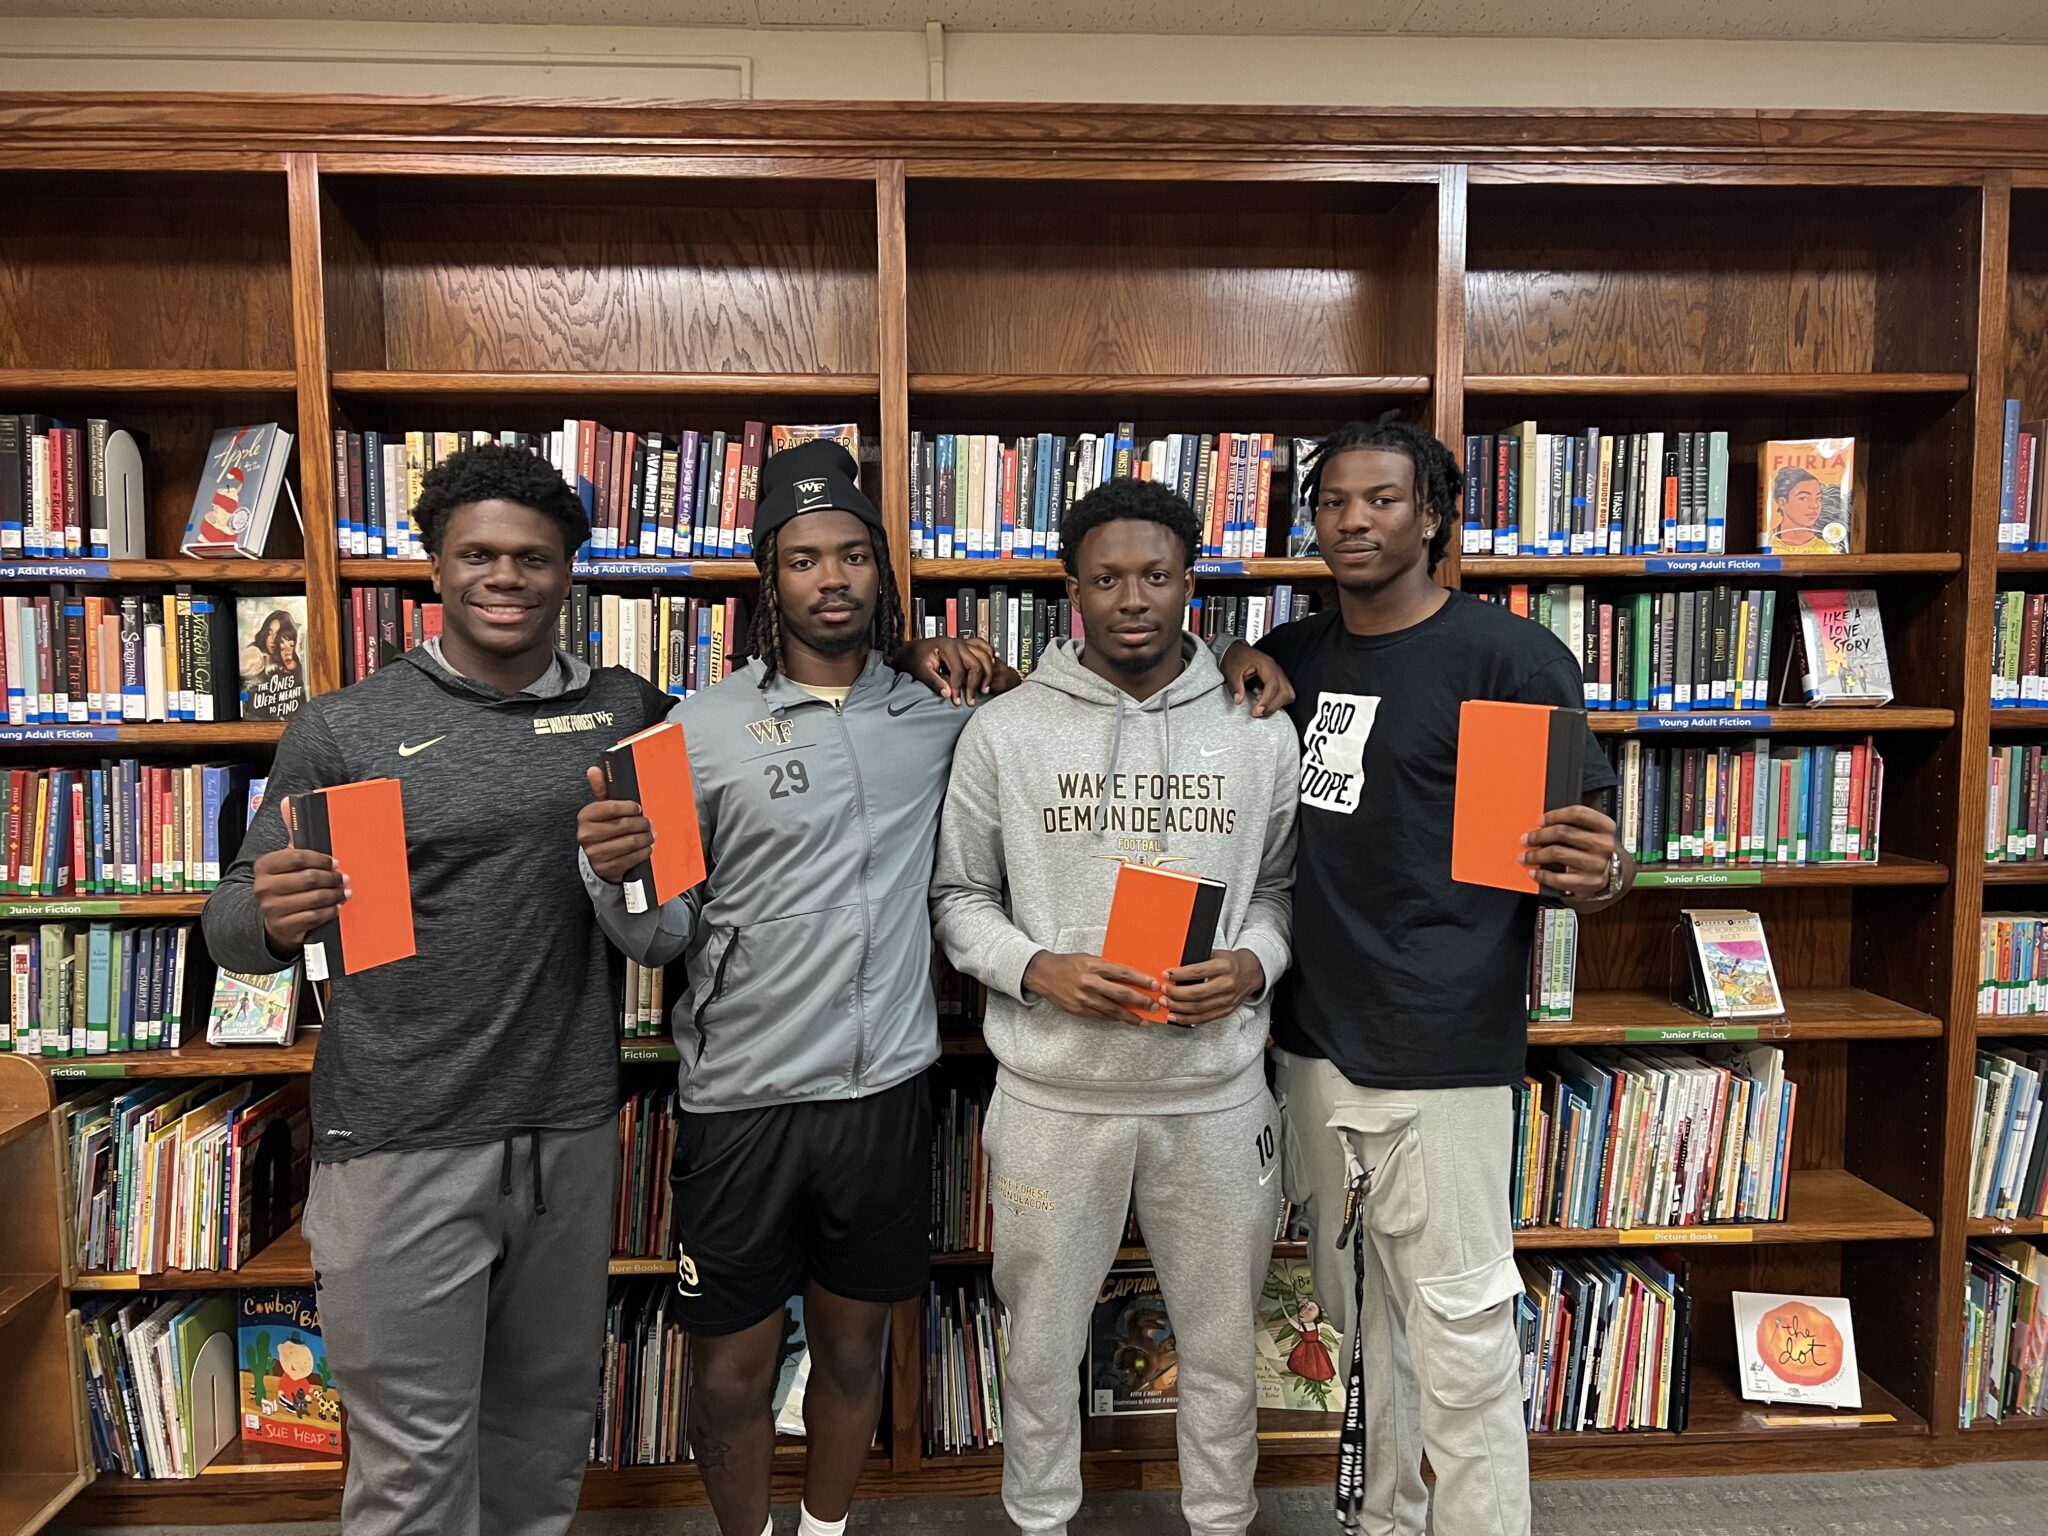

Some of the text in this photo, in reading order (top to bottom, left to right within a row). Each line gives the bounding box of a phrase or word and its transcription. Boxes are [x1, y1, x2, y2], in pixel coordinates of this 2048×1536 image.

[65, 434, 73, 455] ANNIE
[213, 428, 265, 482] Apple
[66, 457, 73, 469] ON
[1774, 454, 1847, 470] FURIA
[66, 471, 74, 482] MY
[739, 464, 749, 499] DERKHOLM
[751, 466, 759, 482] DARK
[1227, 464, 1236, 493] VIETNAM
[1236, 465, 1245, 493] VIETNAM
[1248, 464, 1258, 493] VIETNAM
[644, 460, 660, 511] VAMPIRE
[797, 481, 825, 493] WF
[925, 484, 932, 495] WE
[1182, 477, 1191, 501] YOUN
[1218, 470, 1226, 500] GOLD
[909, 502, 920, 522] yello
[1600, 482, 1609, 528] BUDDY BUSH
[1612, 490, 1624, 519] TRASH
[1498, 510, 1507, 528] BUR
[17, 566, 47, 575] Adult
[50, 566, 86, 575] Fiction
[572, 565, 667, 575] oung Adult Fiction
[1193, 564, 1221, 573] ction
[1667, 560, 1760, 571] Young Adult Fiction
[1747, 605, 1757, 649] CUBA 15
[1823, 608, 1862, 627] LIKE A
[192, 613, 210, 654] Wicked
[1253, 620, 1261, 640] FEMA
[1829, 623, 1861, 640] LOVE
[711, 630, 723, 661] SON
[1036, 632, 1045, 653] RAIN
[1714, 628, 1726, 661] AIRBORN
[1834, 638, 1870, 656] STORY
[688, 645, 697, 674] The Falcon
[1021, 638, 1033, 673] DOLL PEO
[1759, 629, 1771, 679] Perfect Family
[258, 674, 295, 693] THE ONES
[253, 686, 302, 709] WERE MEANT
[269, 699, 299, 717] TO FIND
[1316, 701, 1356, 735] GOD
[1659, 717, 1752, 728] Young Adult Fiction
[25, 730, 54, 739] Adult
[57, 730, 93, 739] Fiction
[745, 717, 794, 746] WF
[1309, 733, 1328, 766] IS
[763, 759, 810, 800] 29
[1057, 772, 1226, 801] WAKE FOREST
[1301, 763, 1354, 806] DOPE.
[1043, 805, 1237, 835] DEMON DEACONS
[1118, 838, 1162, 851] FOOTBAL
[1663, 874, 1728, 883] Junior Fiction
[10, 905, 81, 914] Junior Fiction
[152, 955, 163, 1014] reaching DUSTIN
[1661, 1030, 1725, 1039] Junior Fiction
[624, 1050, 658, 1059] Fiction
[51, 1068, 86, 1077] Fiction
[1256, 1124, 1275, 1168] 10
[1655, 1233, 1718, 1241] Picture Books
[634, 1264, 664, 1272] Books
[1097, 1278, 1158, 1303] CAPTAIN
[300, 1310, 321, 1328] BA
[1782, 1315, 1815, 1338] the
[1778, 1337, 1827, 1366] dot
[265, 1423, 326, 1445] SUE HEAP
